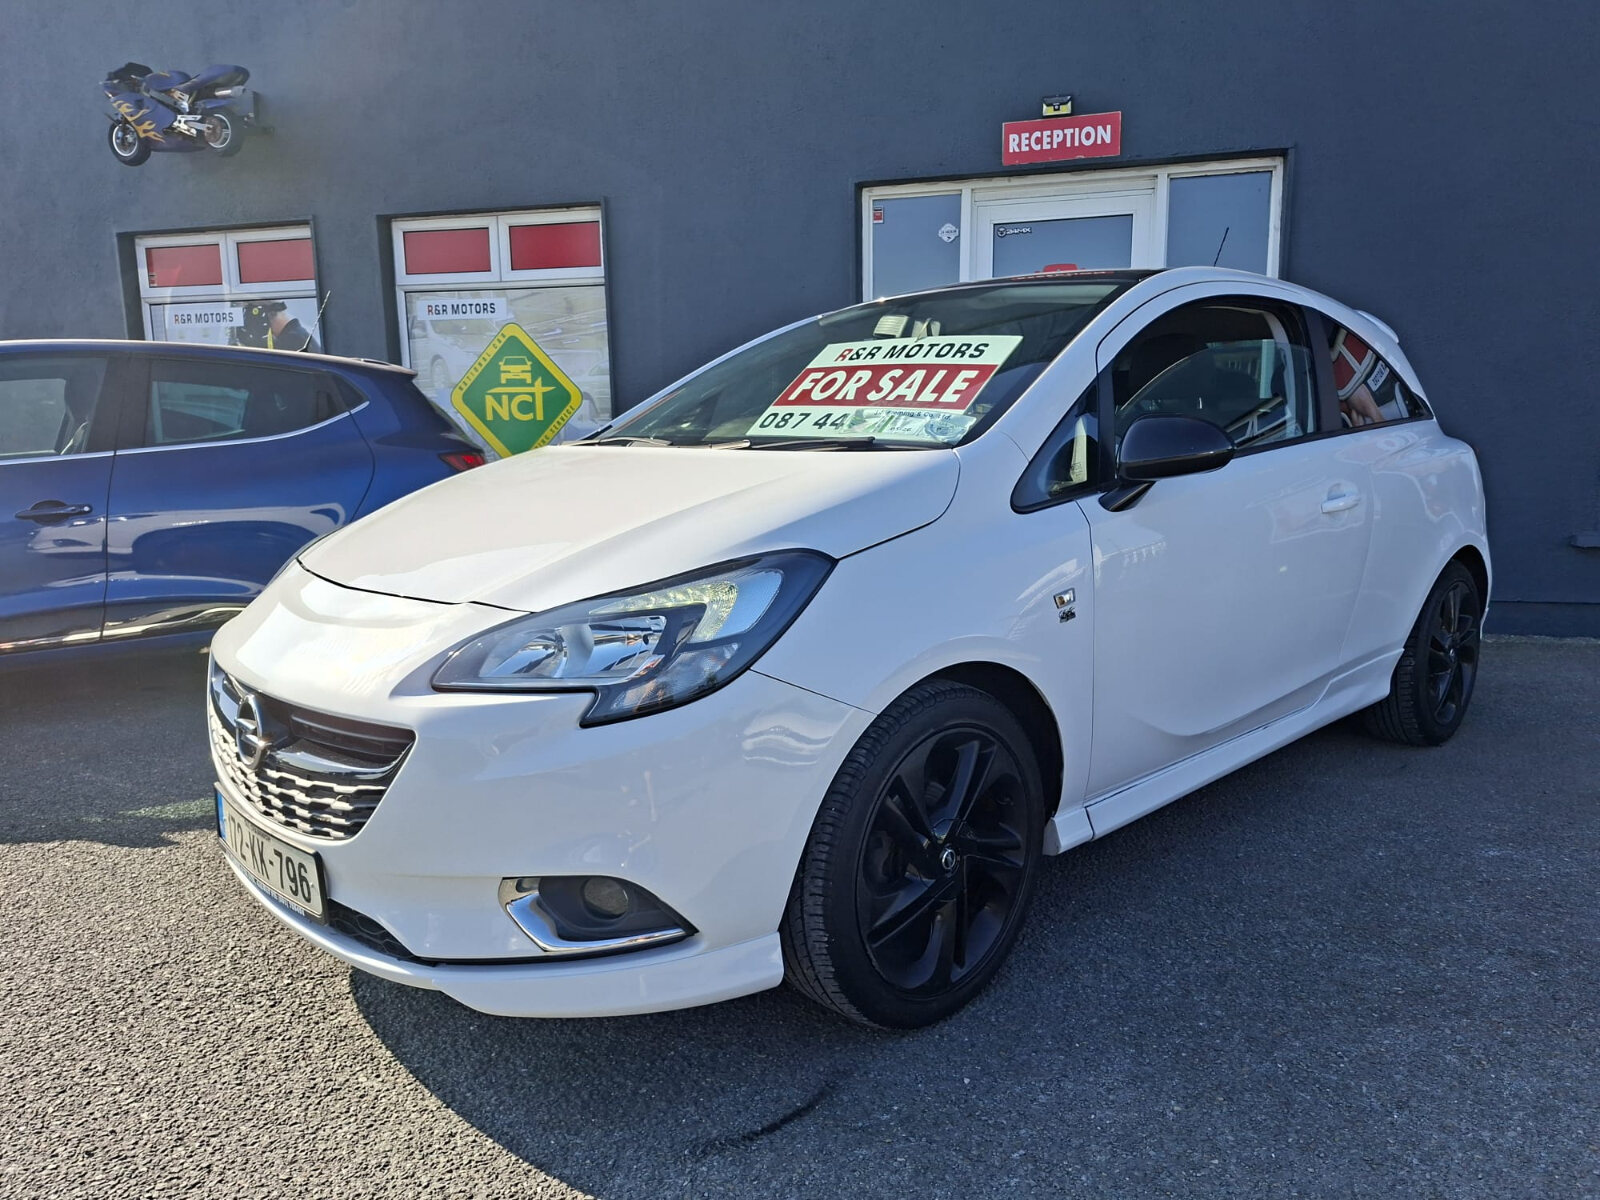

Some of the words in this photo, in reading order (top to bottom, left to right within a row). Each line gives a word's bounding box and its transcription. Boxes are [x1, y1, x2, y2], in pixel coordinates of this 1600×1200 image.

[1008, 124, 1111, 153] RECEPTION
[174, 313, 193, 325] R&R
[194, 312, 234, 324] MOTORS
[427, 304, 448, 316] R&R
[451, 302, 497, 315] MOTORS
[834, 346, 881, 363] R&R
[882, 342, 990, 360] MOTORS
[788, 369, 873, 401] FOR
[866, 368, 980, 403] SALE
[759, 412, 811, 429] 087
